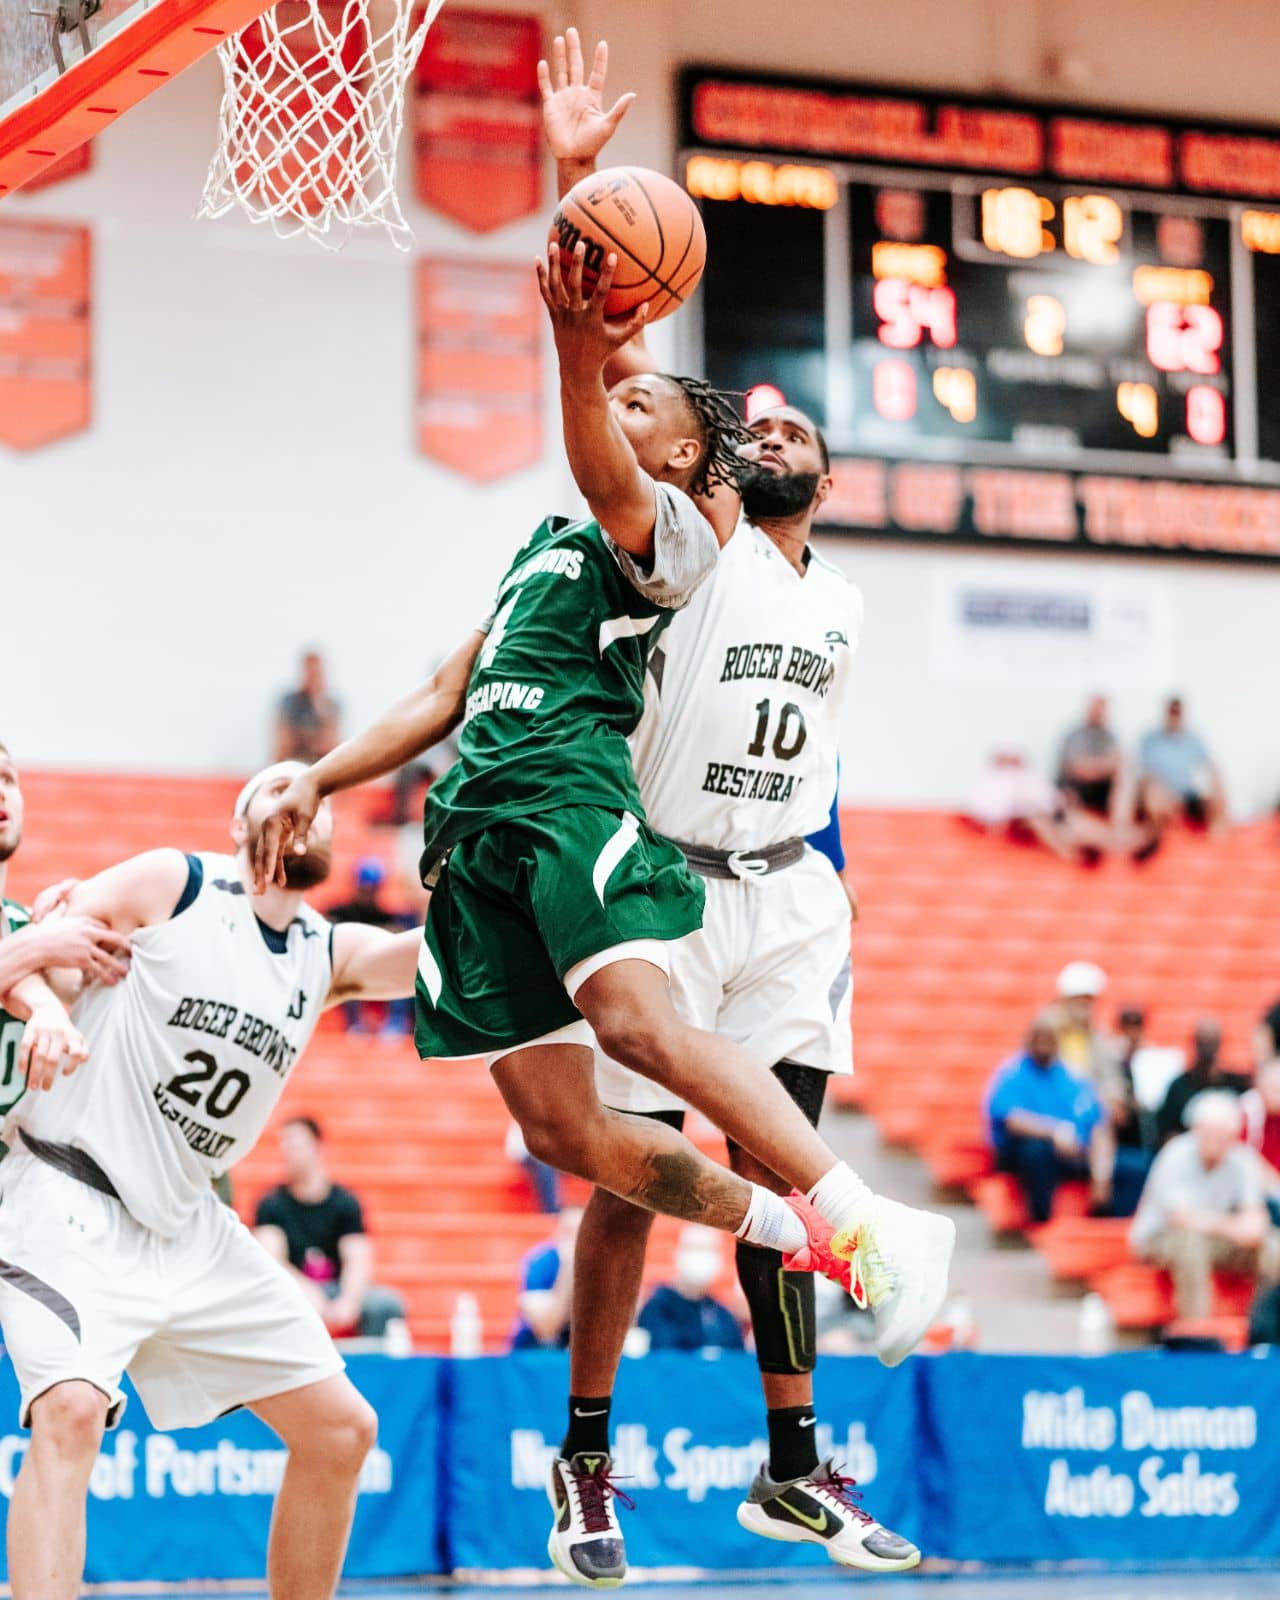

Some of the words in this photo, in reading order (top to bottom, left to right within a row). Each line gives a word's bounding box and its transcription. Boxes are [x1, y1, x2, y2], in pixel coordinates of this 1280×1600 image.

[719, 643, 783, 683] ROGER
[747, 697, 807, 761] 10
[166, 996, 238, 1039] ROGER
[165, 1049, 251, 1119] 20
[1022, 1386, 1116, 1451] Mike
[1121, 1390, 1257, 1451] Duman
[1044, 1458, 1135, 1518] Auto
[1138, 1451, 1240, 1517] Sales
